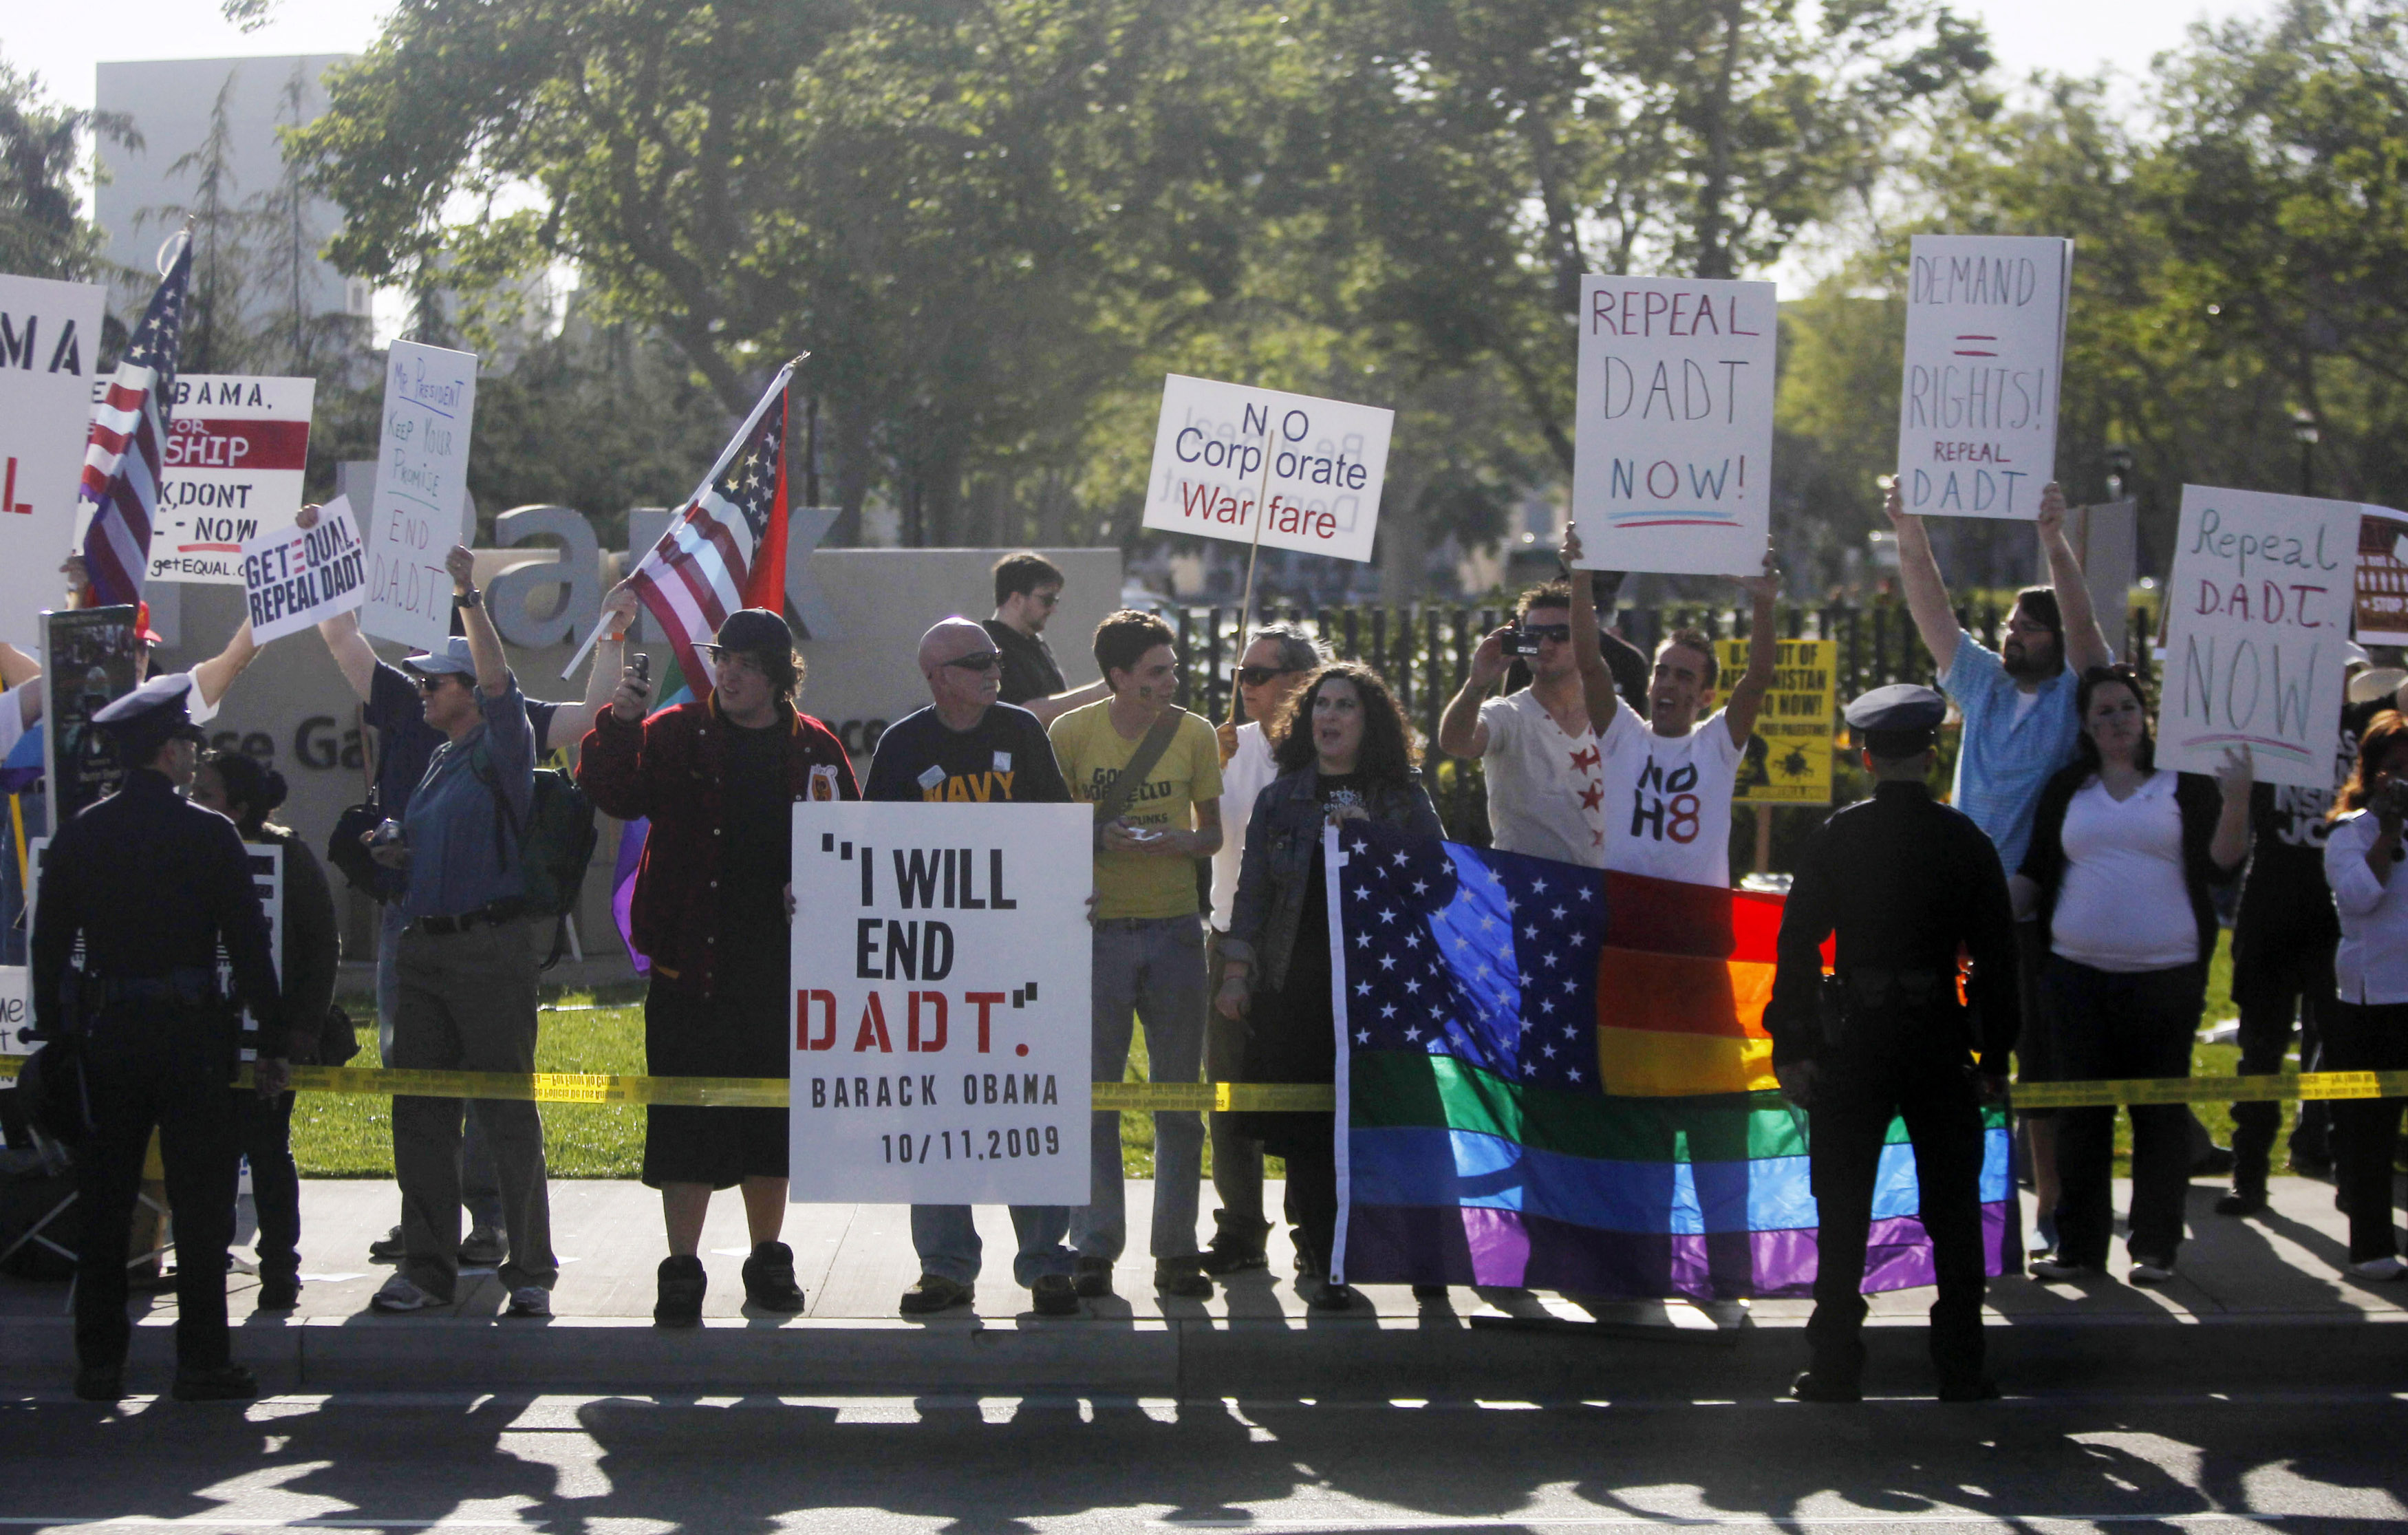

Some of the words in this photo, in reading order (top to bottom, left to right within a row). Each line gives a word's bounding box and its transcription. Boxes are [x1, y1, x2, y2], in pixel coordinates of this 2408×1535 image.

[1914, 256, 2036, 307] DEMAND
[1593, 290, 1760, 336] REPEAL
[1605, 356, 1749, 424] DADT
[1910, 365, 2044, 431] RIGHTS!
[1933, 441, 2012, 462] REPEAL
[1612, 455, 1745, 500] NOW!
[1914, 469, 2028, 513] DADT
[195, 517, 257, 542] NOW
[389, 510, 429, 550] END
[2191, 508, 2338, 578] Repeal
[250, 572, 319, 627] REPEAL
[321, 548, 365, 601] DADT
[2184, 634, 2319, 741] NOW
[1637, 755, 1699, 794] NO
[1631, 788, 1700, 844] H8
[893, 849, 1017, 910] WILL
[856, 919, 954, 980] END
[812, 1075, 937, 1108] BARACK
[965, 1074, 1058, 1106] OBAMA
[881, 1126, 1060, 1164] 10/11.2009
